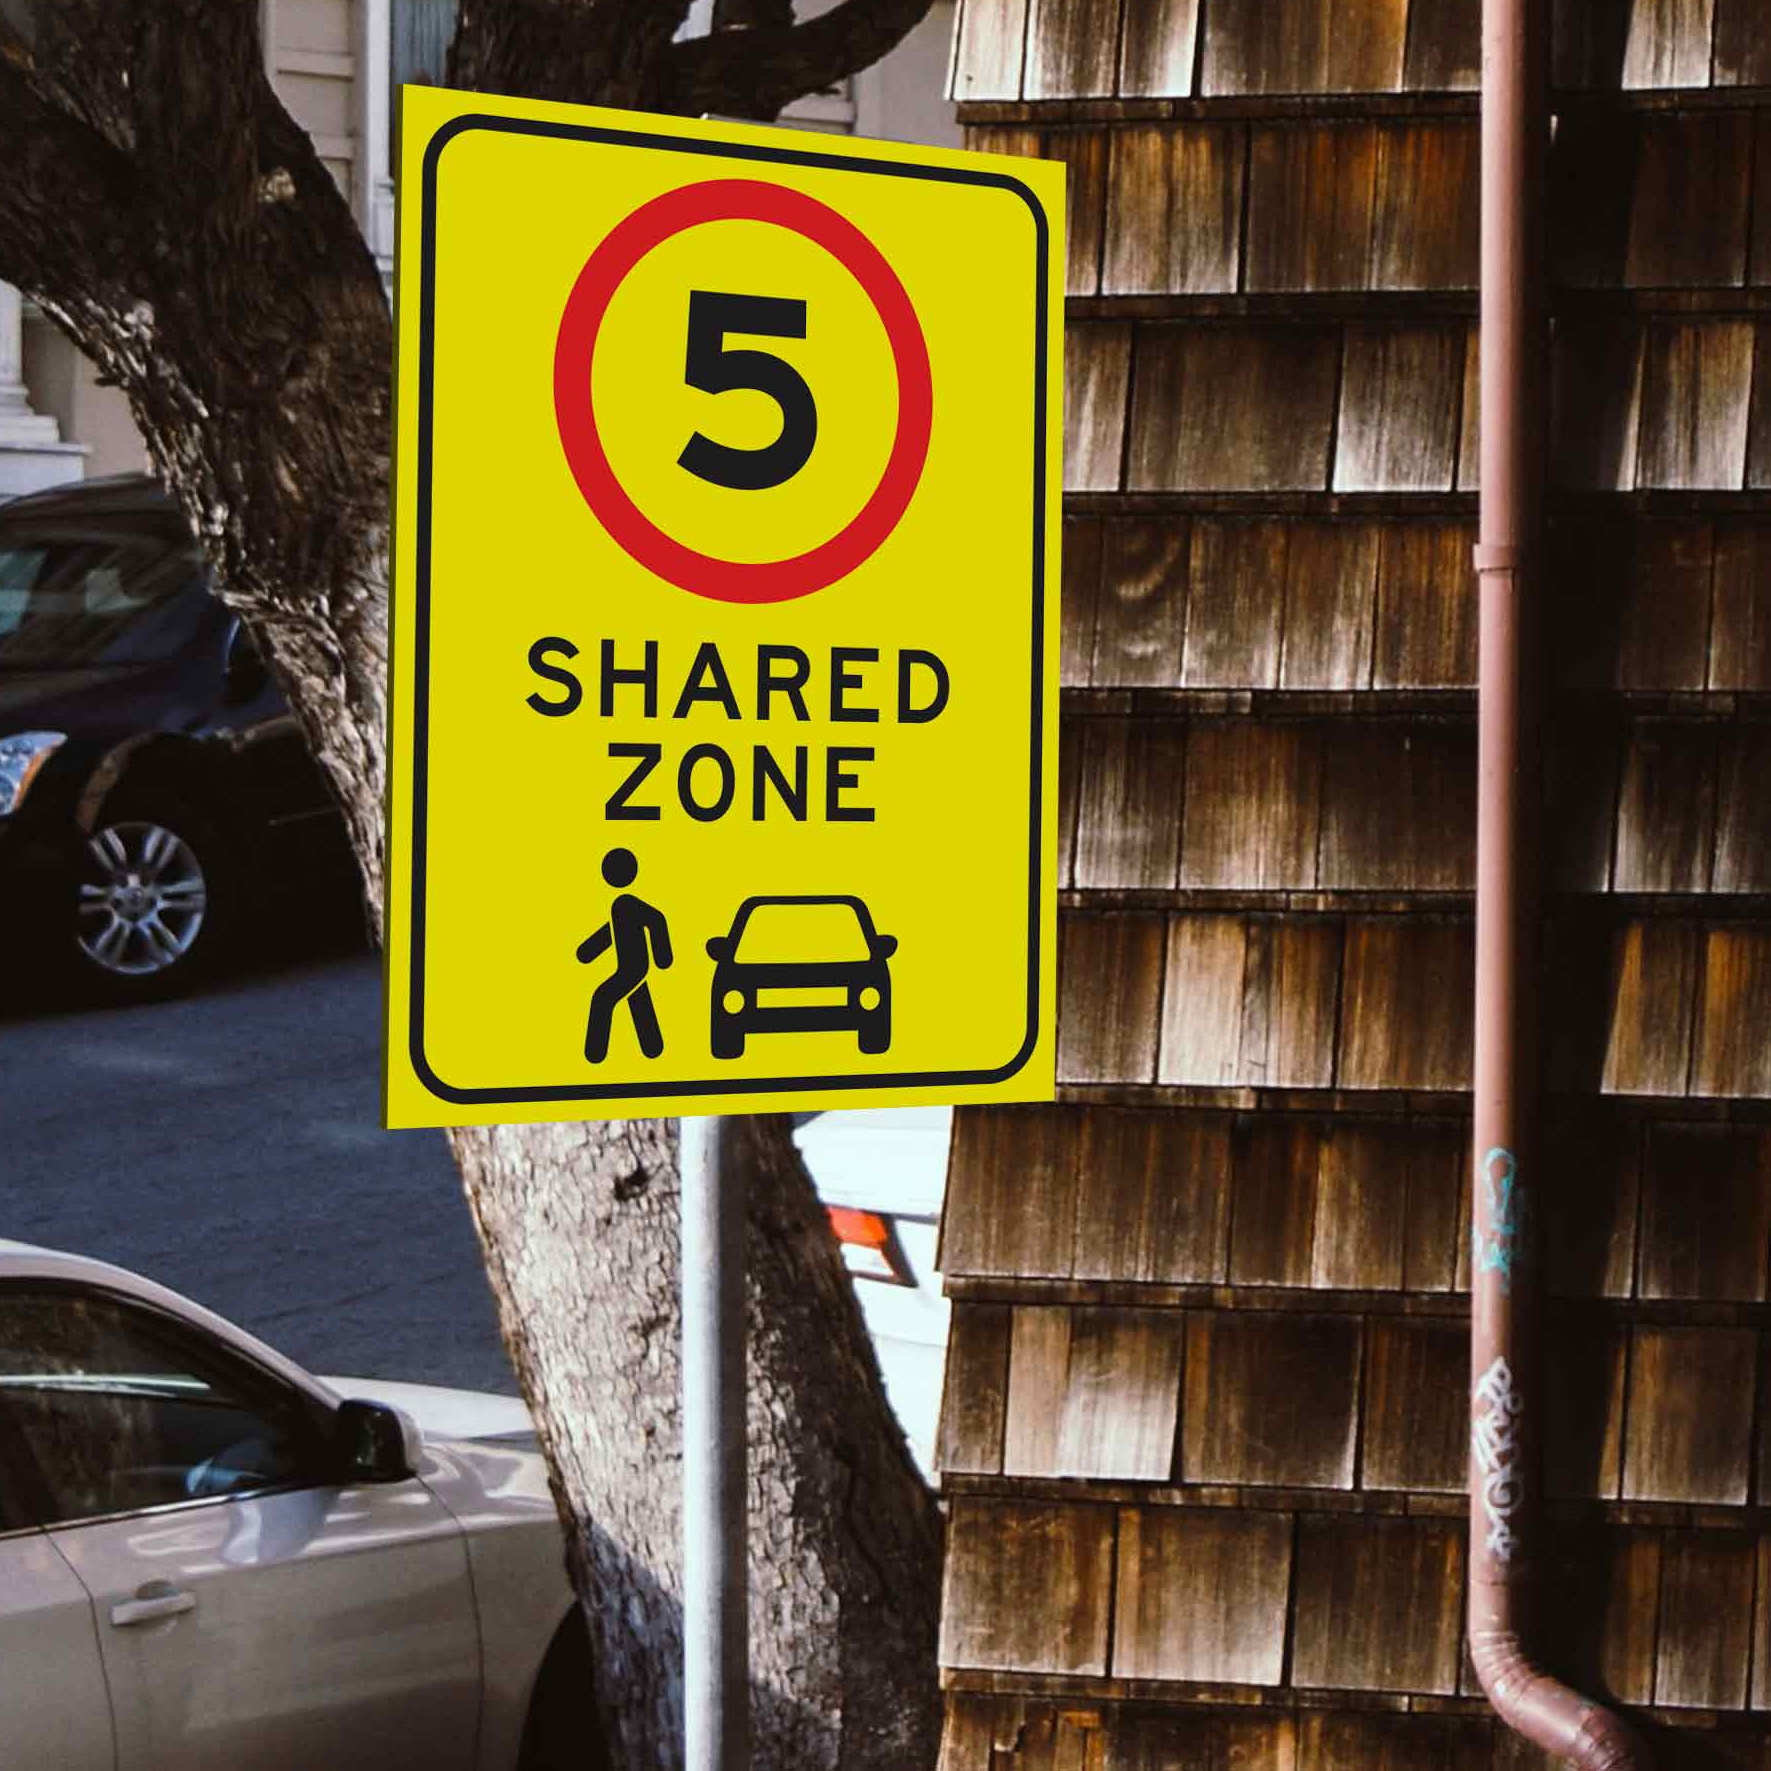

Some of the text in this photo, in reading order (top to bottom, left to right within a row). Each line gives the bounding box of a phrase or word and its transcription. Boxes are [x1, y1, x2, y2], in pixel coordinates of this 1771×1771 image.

[676, 289, 818, 492] 5
[525, 635, 951, 725] SHARED
[604, 742, 876, 823] ZONE
